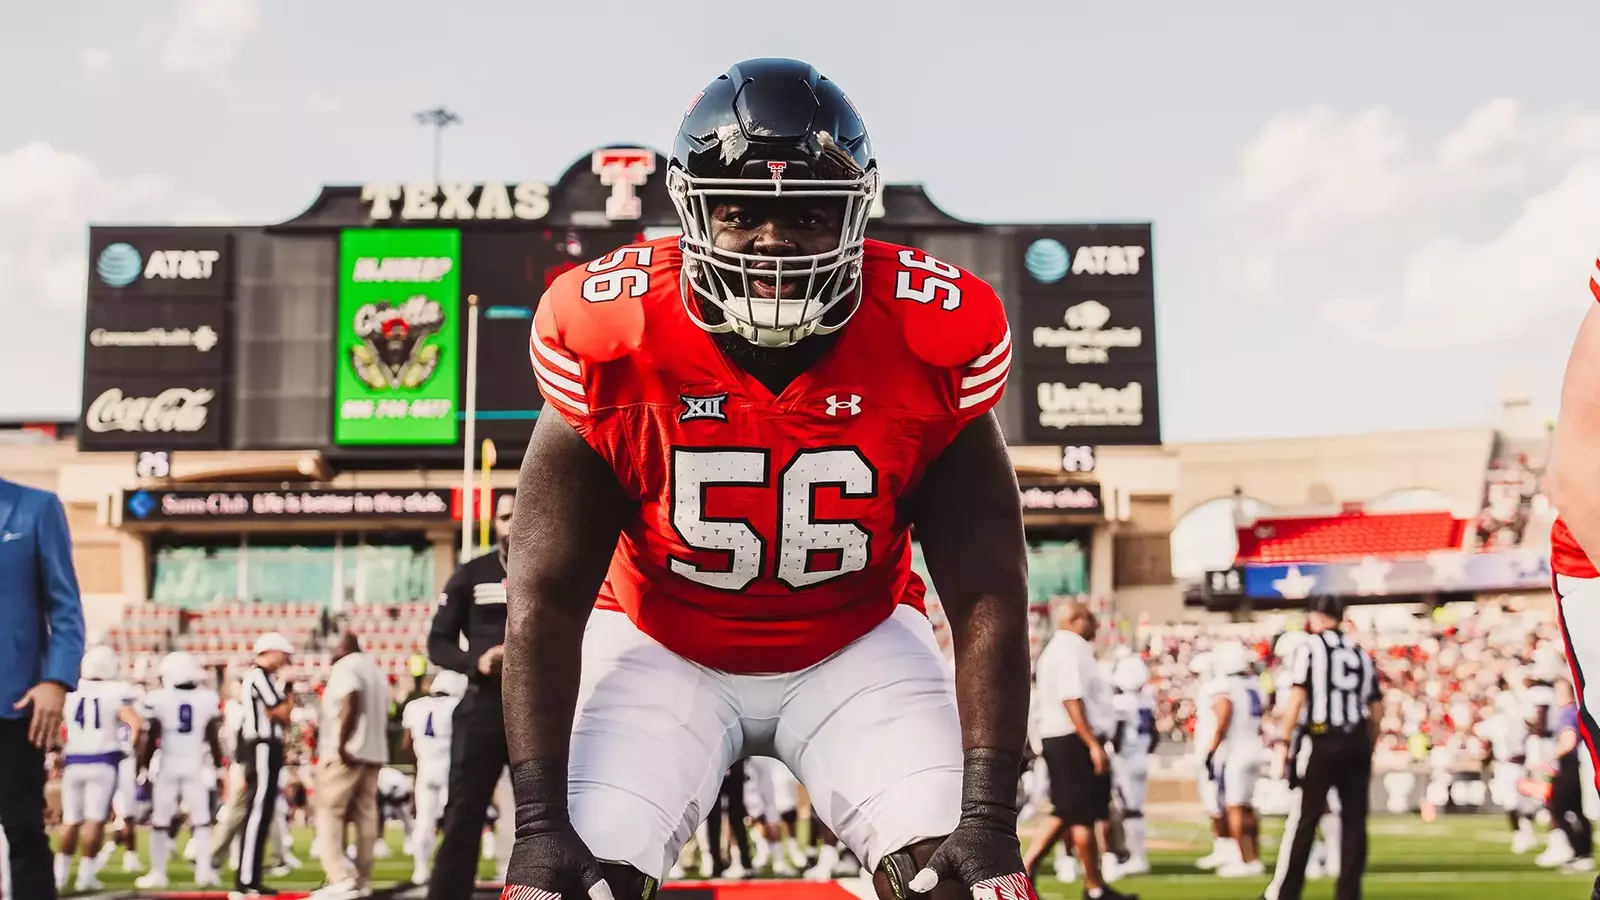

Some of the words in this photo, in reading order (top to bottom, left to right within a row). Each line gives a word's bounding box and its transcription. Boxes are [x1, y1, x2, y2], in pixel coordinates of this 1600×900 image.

[362, 183, 550, 220] TEXAS
[143, 249, 220, 280] AT&T
[581, 246, 654, 303] 56
[1071, 245, 1145, 276] AT&T
[895, 249, 962, 311] 56
[667, 446, 879, 594] 56
[1330, 647, 1361, 691] C
[74, 697, 101, 729] 41
[177, 703, 193, 734] 9
